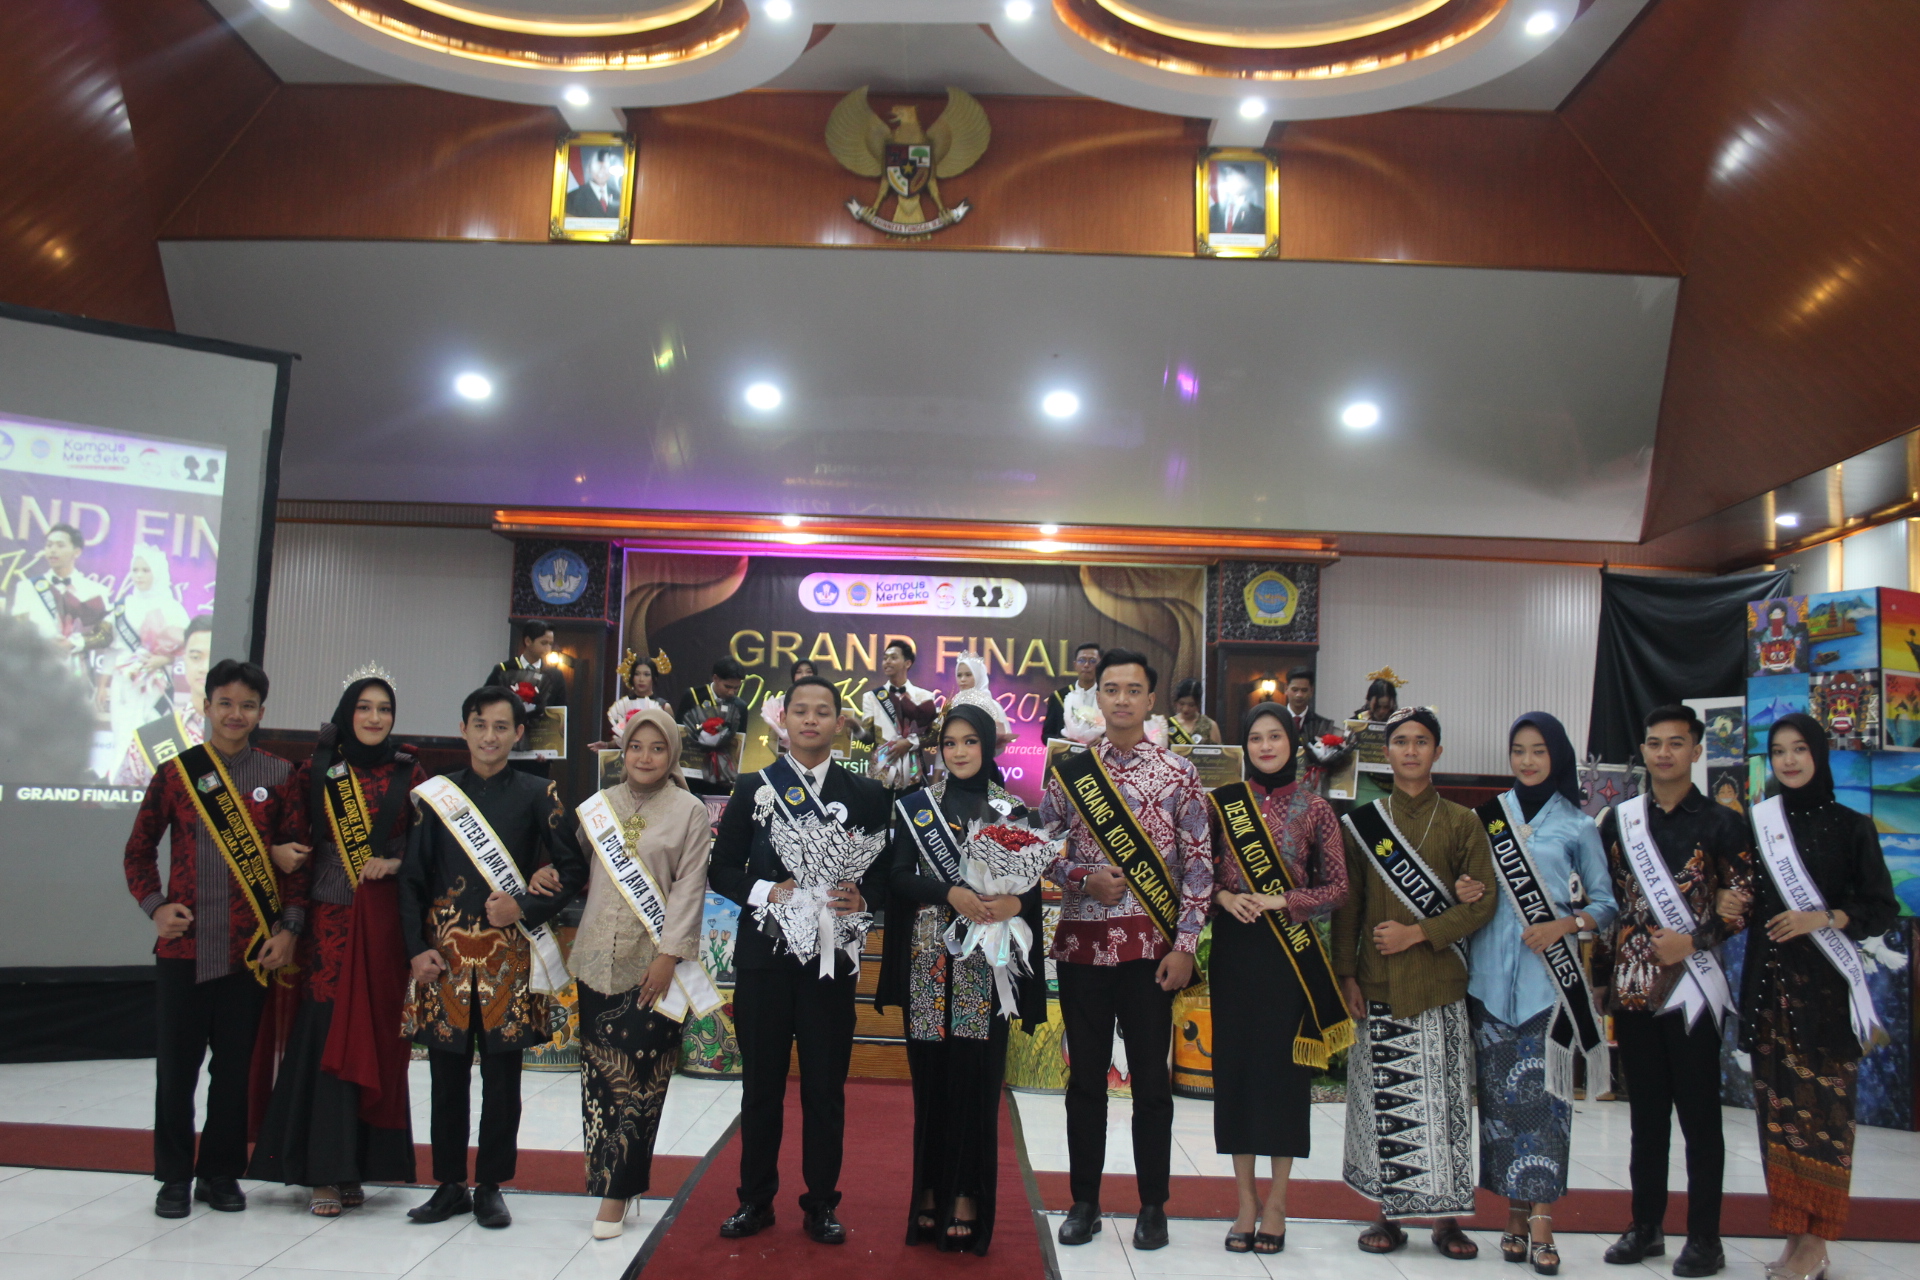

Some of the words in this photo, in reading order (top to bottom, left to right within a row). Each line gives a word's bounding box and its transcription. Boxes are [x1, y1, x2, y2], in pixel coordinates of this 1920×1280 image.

[62, 451, 131, 464] Merdeka
[63, 438, 126, 453] Kampus
[876, 580, 926, 592] Kampus
[876, 590, 929, 602] Merdeka
[936, 635, 1079, 677] FINAL
[17, 787, 80, 801] GRAND
[83, 789, 129, 802] FINAL
[337, 779, 353, 800] DUTA
[343, 799, 361, 824] GENRE
[215, 791, 231, 814] DUTA
[226, 811, 248, 838] GENRE
[250, 855, 274, 897] SEMARANG
[221, 828, 240, 854] JUARA
[239, 859, 257, 886] PUTRA
[338, 817, 353, 843] JUARA
[349, 850, 363, 874] PUTR
[455, 811, 490, 851] PUTERA
[477, 847, 509, 877] JAWA
[924, 828, 951, 862] PUTRI
[1073, 773, 1114, 826] KENANG
[1105, 824, 1138, 863] KOTA
[1129, 860, 1179, 929] SEMARANG
[1224, 799, 1255, 839] DENOK
[1240, 840, 1273, 879] KOTA
[602, 834, 633, 873] PUTERI
[619, 870, 650, 899] JAWA
[1391, 858, 1436, 909] DUTA
[1494, 839, 1532, 892] DUTA
[1518, 890, 1549, 923] FIK
[1545, 942, 1578, 988] NNES
[1632, 841, 1660, 888] PUTRA
[1653, 887, 1691, 935] KAMP
[1691, 950, 1712, 975] 024
[1776, 856, 1799, 887] PUTRI
[1817, 926, 1854, 967] AVORITE
